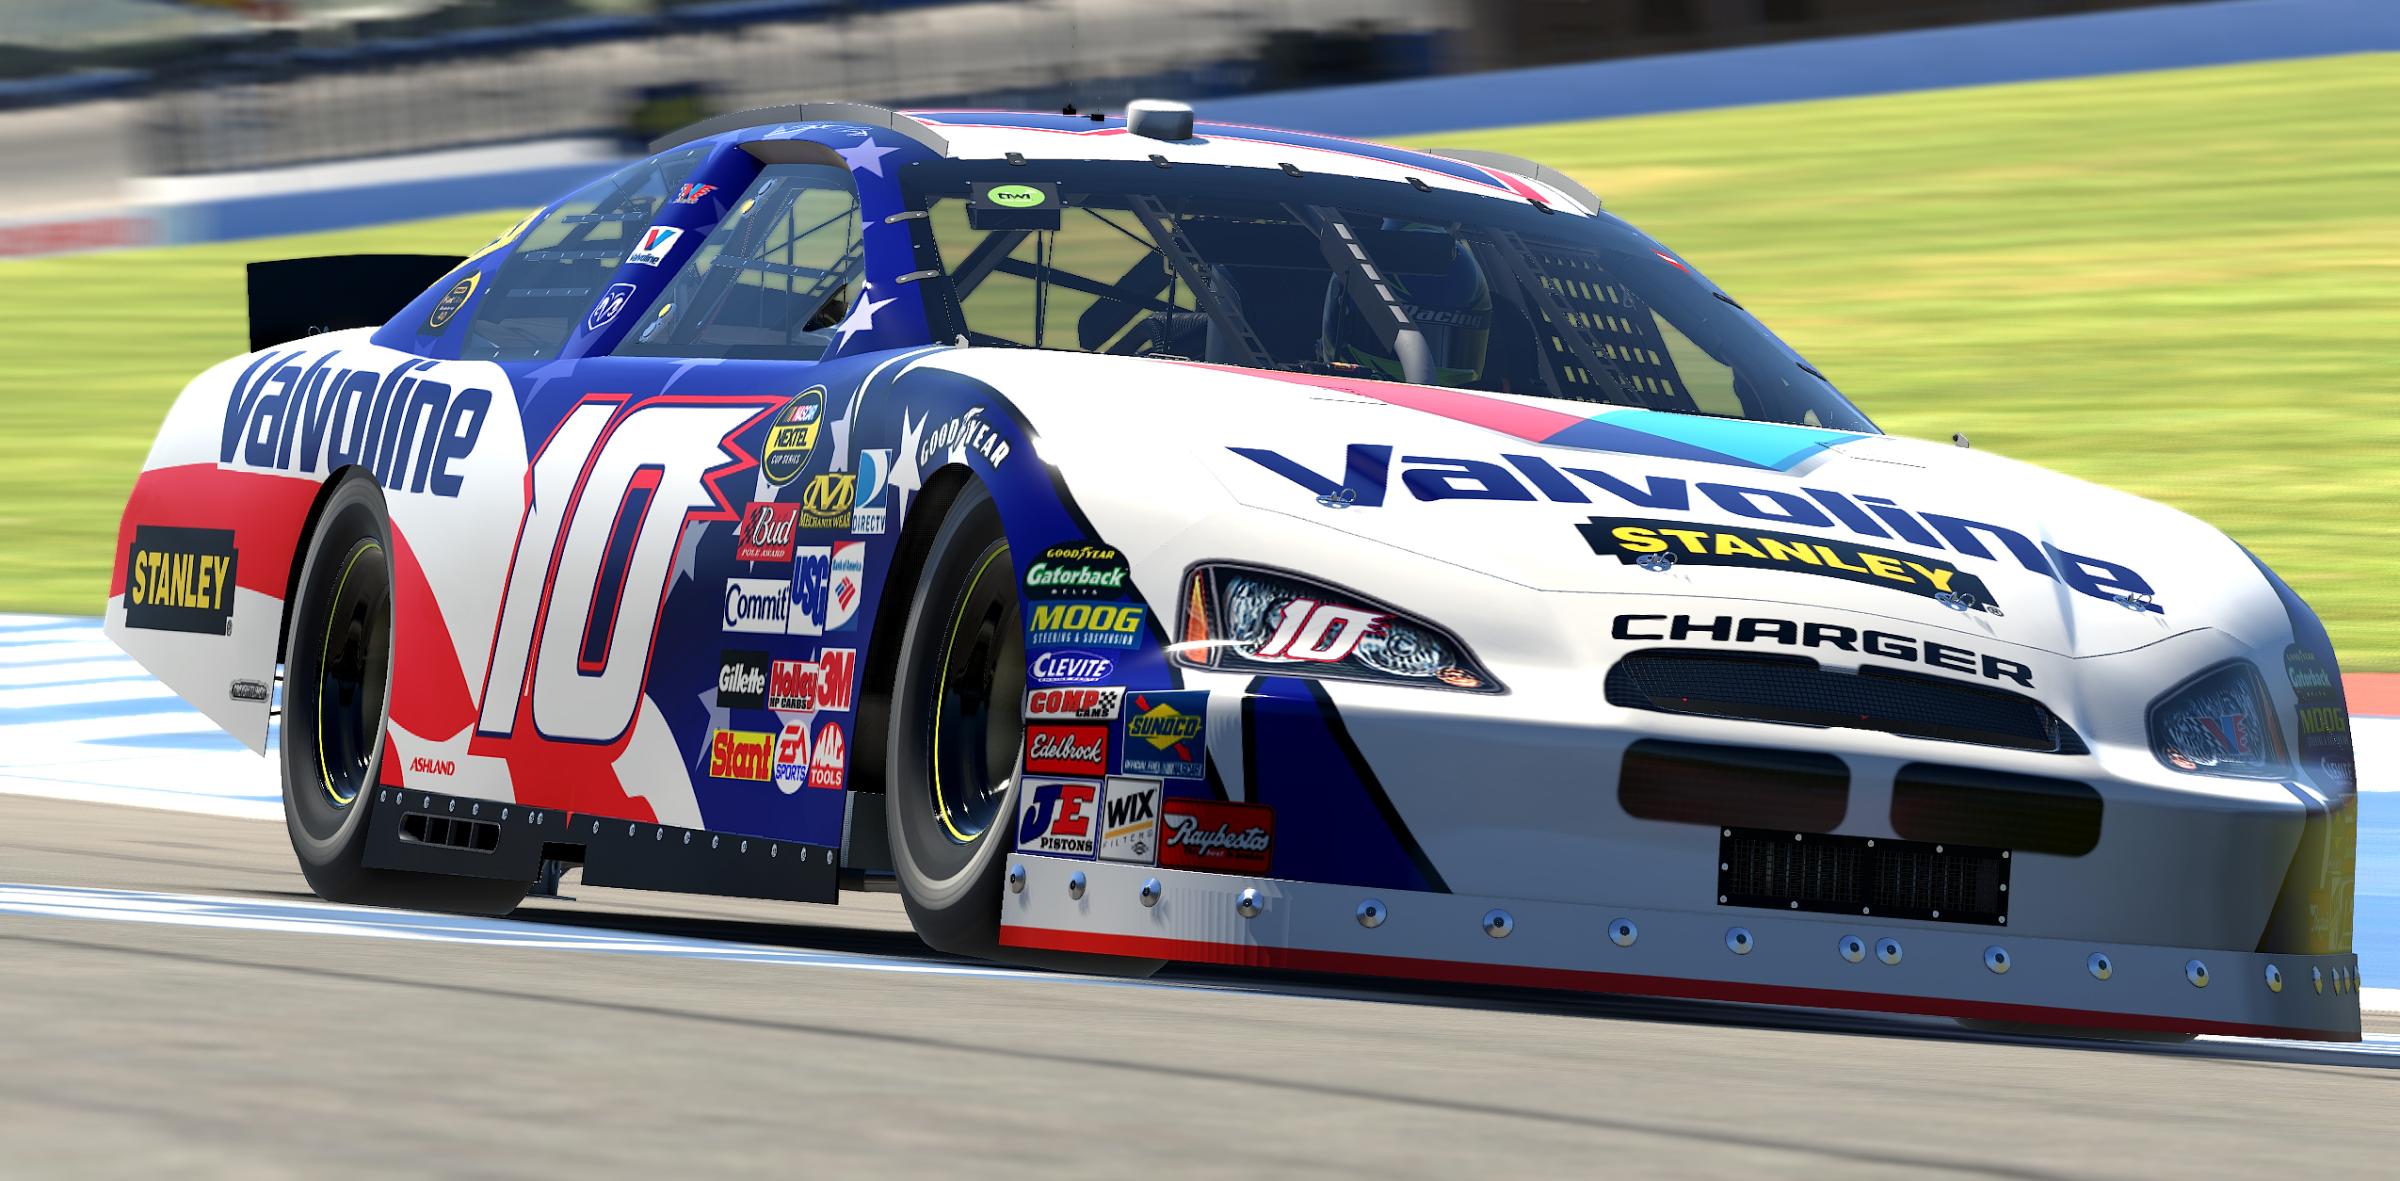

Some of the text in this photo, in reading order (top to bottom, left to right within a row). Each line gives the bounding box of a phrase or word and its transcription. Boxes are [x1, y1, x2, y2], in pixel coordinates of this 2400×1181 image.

[219, 349, 493, 499] Valvoline
[773, 427, 809, 449] NEXTEL
[752, 506, 798, 547] Bud
[853, 515, 886, 532] DIRECTV
[1225, 443, 2165, 614] Valvoline
[132, 549, 231, 610] STANLEY
[474, 394, 790, 746] 10
[1026, 562, 1127, 588] Gatorback
[1610, 525, 1954, 594] STANLEY
[724, 583, 786, 627] Commit
[791, 555, 829, 628] USG
[1030, 604, 1143, 633] MOOG
[1032, 632, 1072, 644] STEERING
[1083, 632, 1134, 646] SUSPENSION
[1254, 598, 1395, 662] 10
[1033, 652, 1112, 678] CLEVITE
[1611, 613, 2035, 690] CHARGER
[719, 663, 766, 695] Gillette
[771, 662, 817, 710] Holley
[817, 651, 854, 709] 3M
[1030, 689, 1099, 714] COMP
[1076, 709, 1109, 717] CAMS
[1131, 717, 1200, 737] SUNOCO
[409, 756, 456, 776] ASHLAND
[711, 731, 772, 780] Stant
[1030, 734, 1102, 763] Edelbrock
[776, 764, 806, 781] SPORTS
[811, 769, 842, 785] TOOLS
[1020, 783, 1096, 845] JE
[1107, 788, 1155, 829] WIX
[1040, 837, 1093, 852] PISTONS
[1164, 814, 1270, 855] Raybestos
